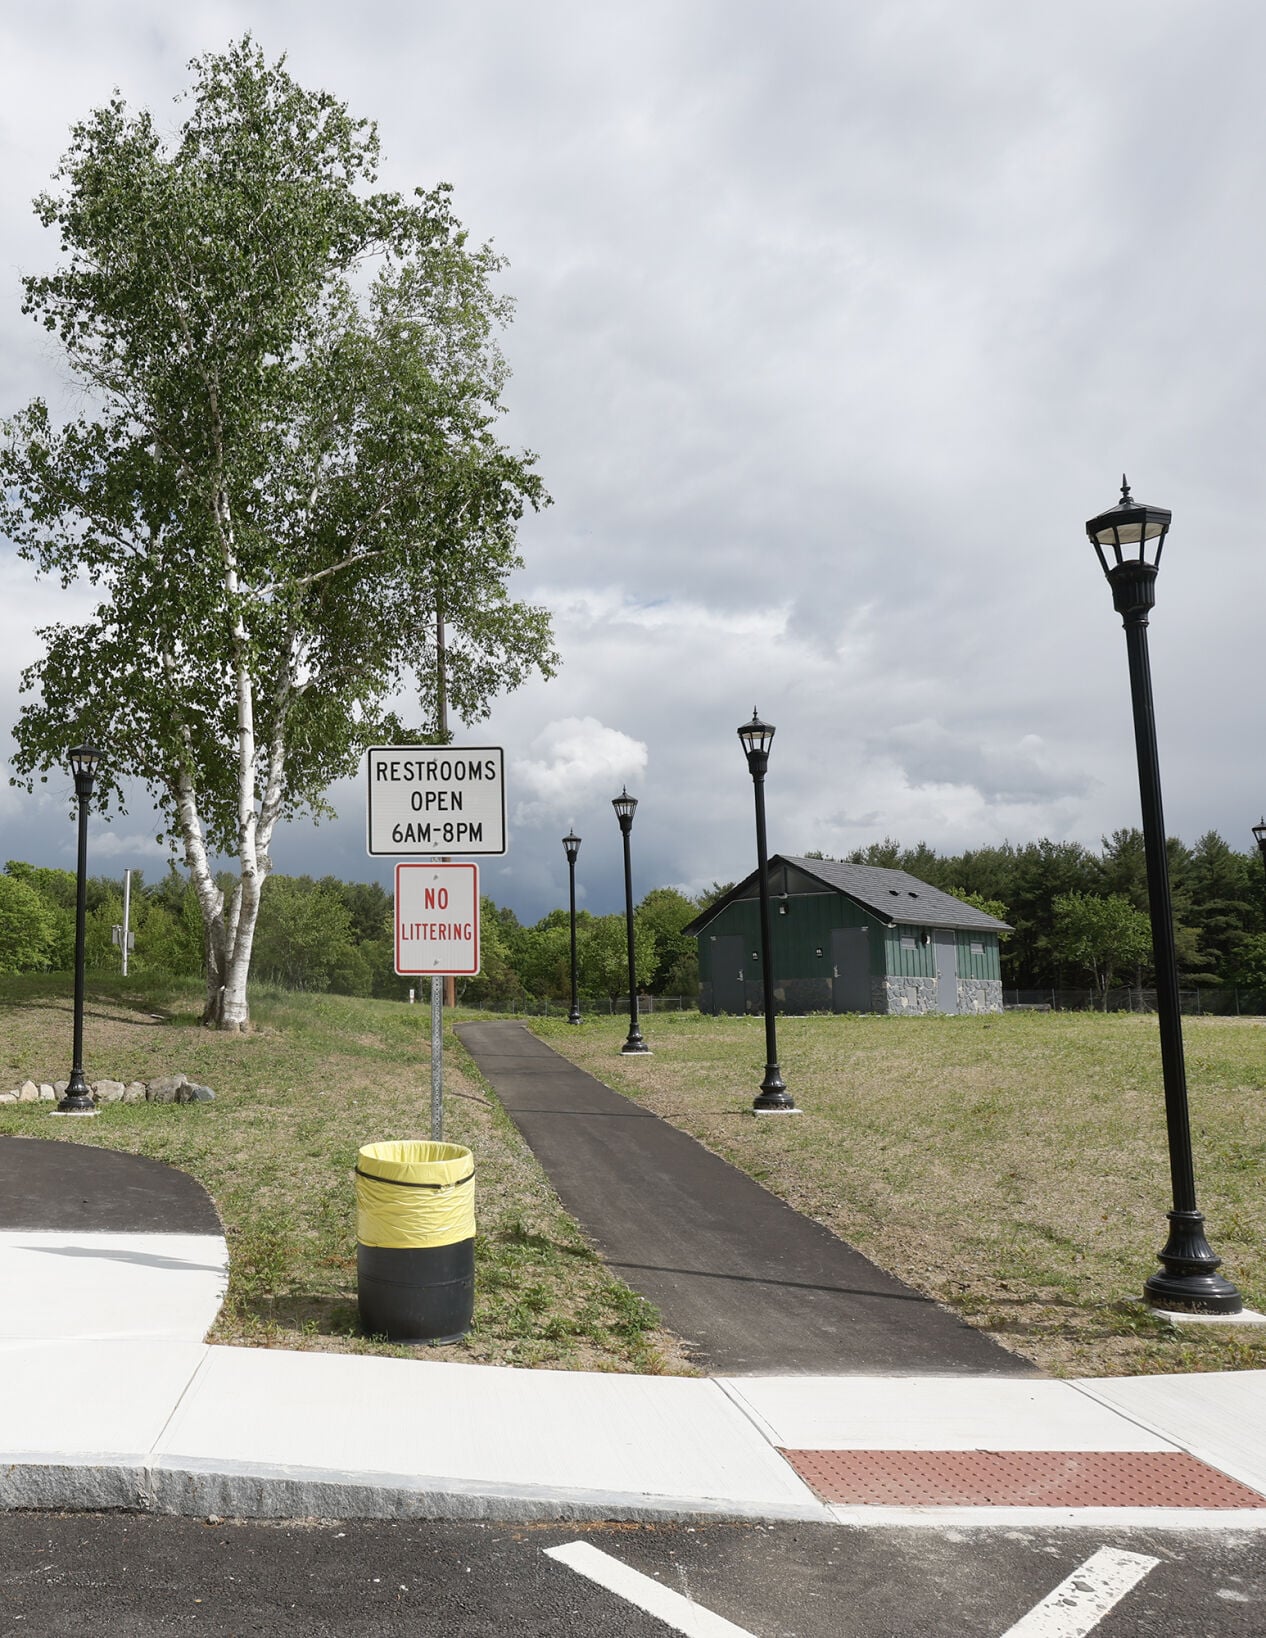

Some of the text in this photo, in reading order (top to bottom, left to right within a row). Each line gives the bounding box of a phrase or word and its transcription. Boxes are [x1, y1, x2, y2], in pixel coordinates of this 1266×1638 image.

[376, 760, 496, 781] RESTROOMS
[411, 791, 463, 811] OPEN
[391, 822, 483, 843] 6AM-8PM
[424, 887, 449, 909] NO
[401, 923, 472, 941] LITTERING
